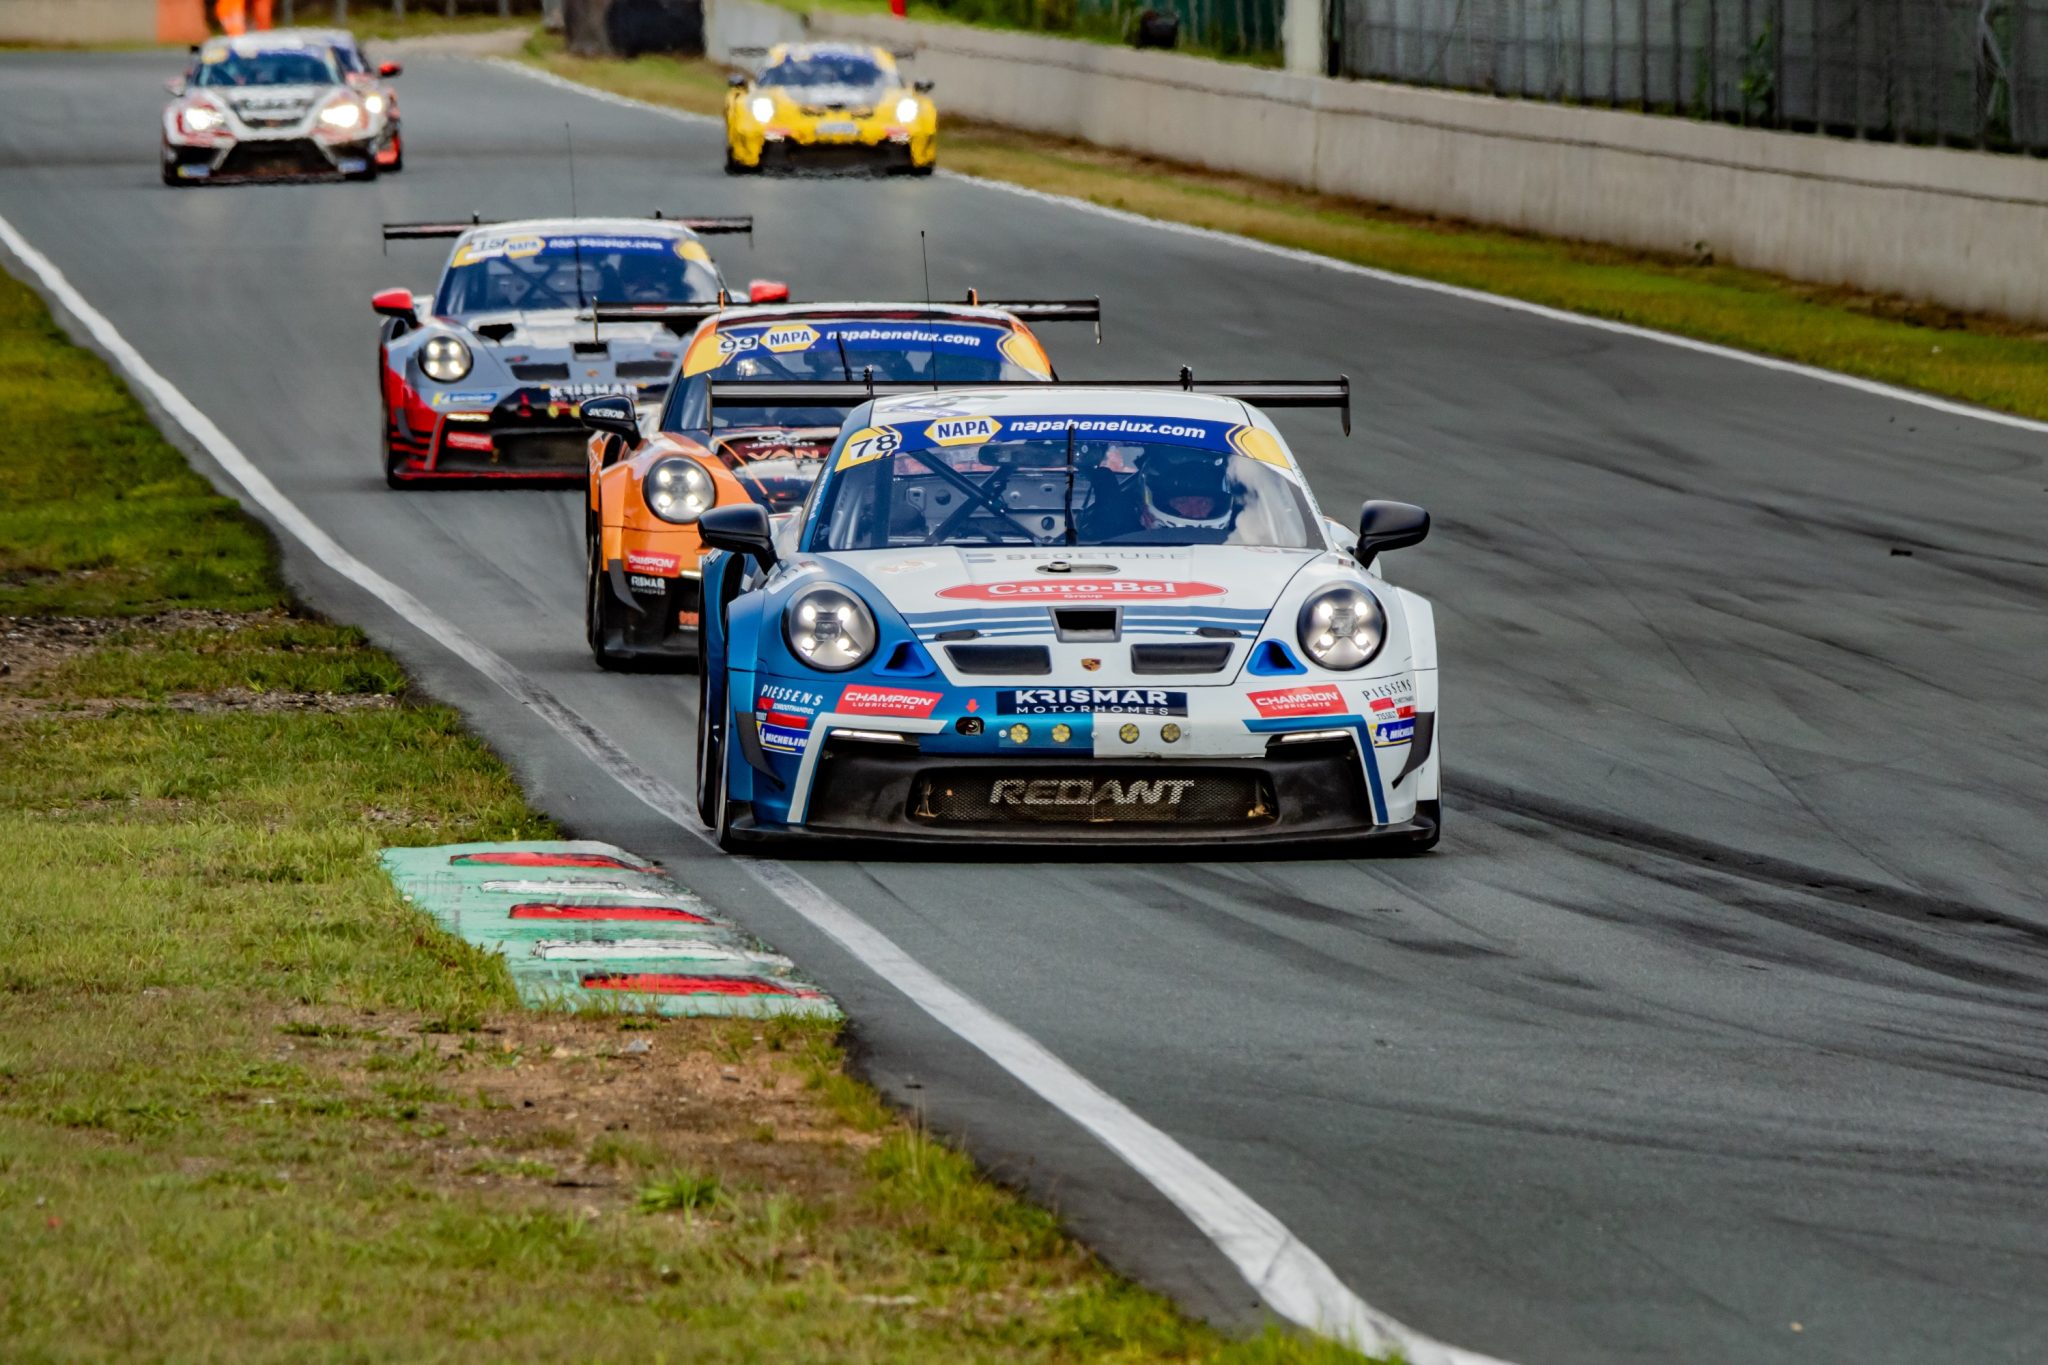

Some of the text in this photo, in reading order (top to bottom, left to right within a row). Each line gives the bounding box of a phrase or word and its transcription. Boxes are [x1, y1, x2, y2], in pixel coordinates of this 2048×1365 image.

[719, 336, 757, 354] 99
[769, 330, 811, 345] NAPA
[826, 329, 981, 346] napabenelux.com
[937, 418, 991, 440] NAPA
[1009, 419, 1206, 439] napabenelux.com
[851, 433, 898, 459] 78
[987, 581, 1176, 596] Carro-Bel
[761, 684, 824, 707] PIESSENS
[1015, 689, 1168, 705] KRISMAR
[1362, 679, 1413, 700] PIESSENS
[844, 692, 934, 706] CHAMPION
[852, 702, 915, 710] LUBRICANTS
[1256, 691, 1339, 706] CHAMPION
[1272, 701, 1331, 711] LUBRICANTS
[1016, 705, 1169, 716] MOTORHOMES
[765, 733, 808, 748] MICHELIN
